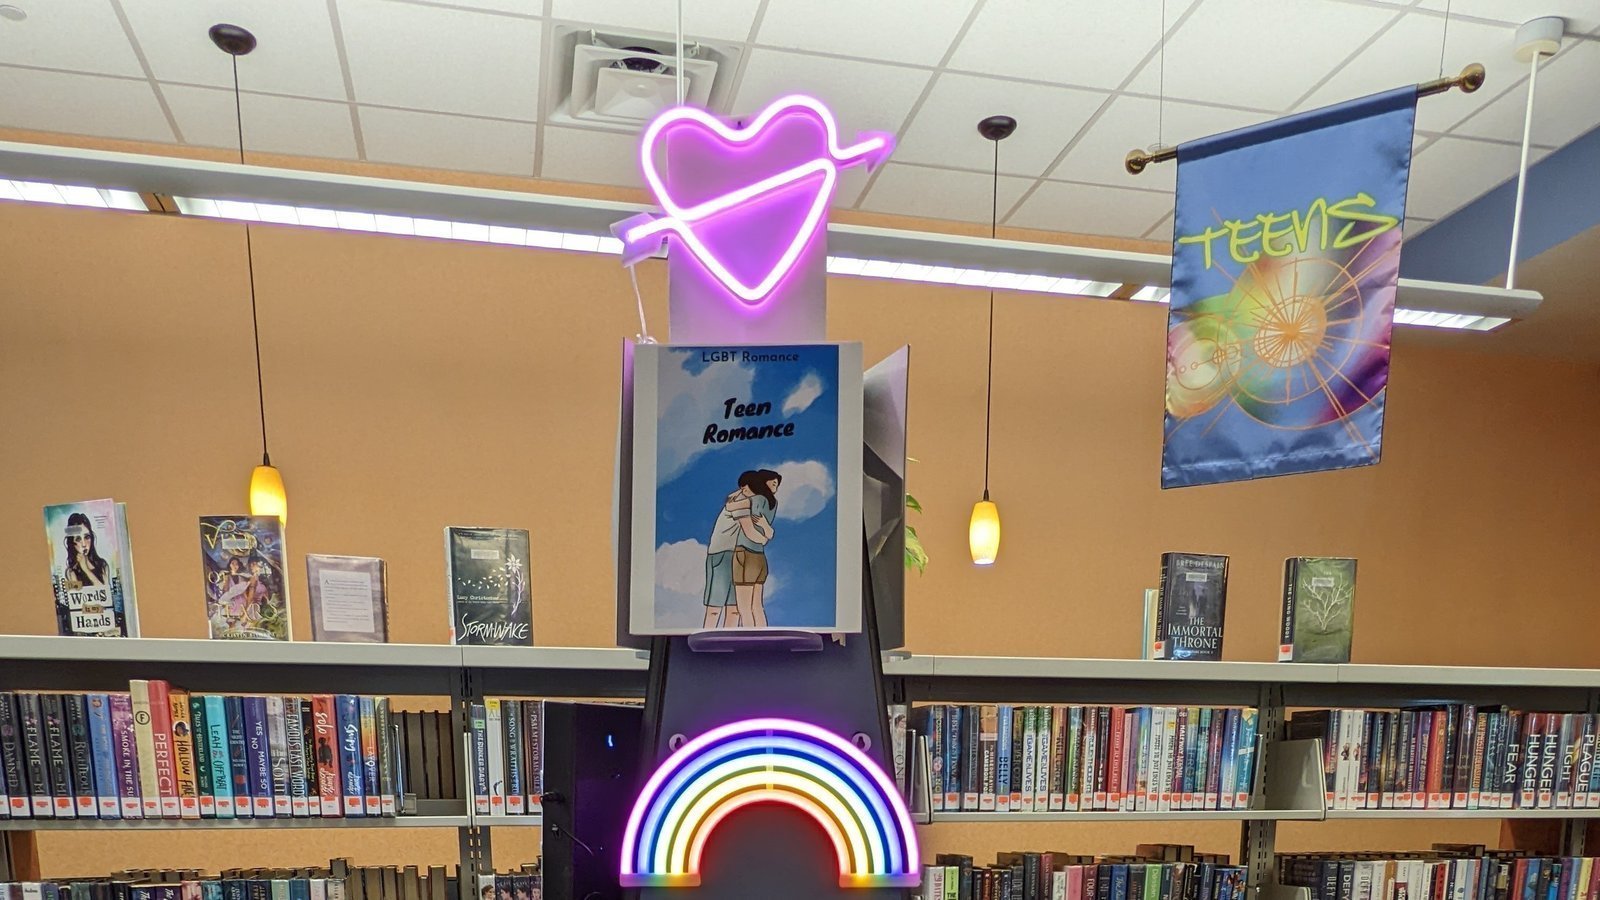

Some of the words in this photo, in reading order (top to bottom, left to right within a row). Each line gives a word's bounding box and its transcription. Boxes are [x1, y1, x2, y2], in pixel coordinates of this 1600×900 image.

[1178, 192, 1398, 270] TEENS
[702, 351, 737, 362] LGBT
[742, 351, 799, 362] Romance
[723, 397, 772, 420] Teen
[703, 422, 795, 445] Romance
[76, 615, 111, 629] Hands
[1168, 624, 1223, 638] IMMORTAL
[1189, 617, 1205, 626] THE
[1172, 636, 1218, 649] THRONE
[210, 725, 220, 749] LEAH
[286, 714, 299, 748] FAMOUS
[508, 717, 516, 738] SONG
[530, 714, 538, 738] PSALM
[27, 727, 41, 766] FLAME
[49, 727, 63, 766] FLAME
[121, 730, 130, 757] SMOKE
[251, 738, 258, 750] NO
[3, 742, 16, 787] DAMNED
[123, 760, 131, 768] IN
[154, 734, 172, 795] PERFECT
[175, 740, 192, 775] HOLLOW
[257, 751, 266, 777] MAYBE
[289, 750, 302, 767] LAST
[532, 742, 540, 771] STORMS
[1505, 744, 1520, 783] FEAR
[1562, 745, 1574, 780] LIGHT
[1577, 734, 1594, 792] PLAGUE
[125, 770, 134, 784] THE
[478, 767, 486, 786] DIARY
[999, 756, 1008, 785] BELLY
[1185, 752, 1195, 790] FROZE
[260, 779, 267, 789] SO
[1326, 876, 1337, 897] DEFY
[1341, 874, 1352, 900] DEFY
